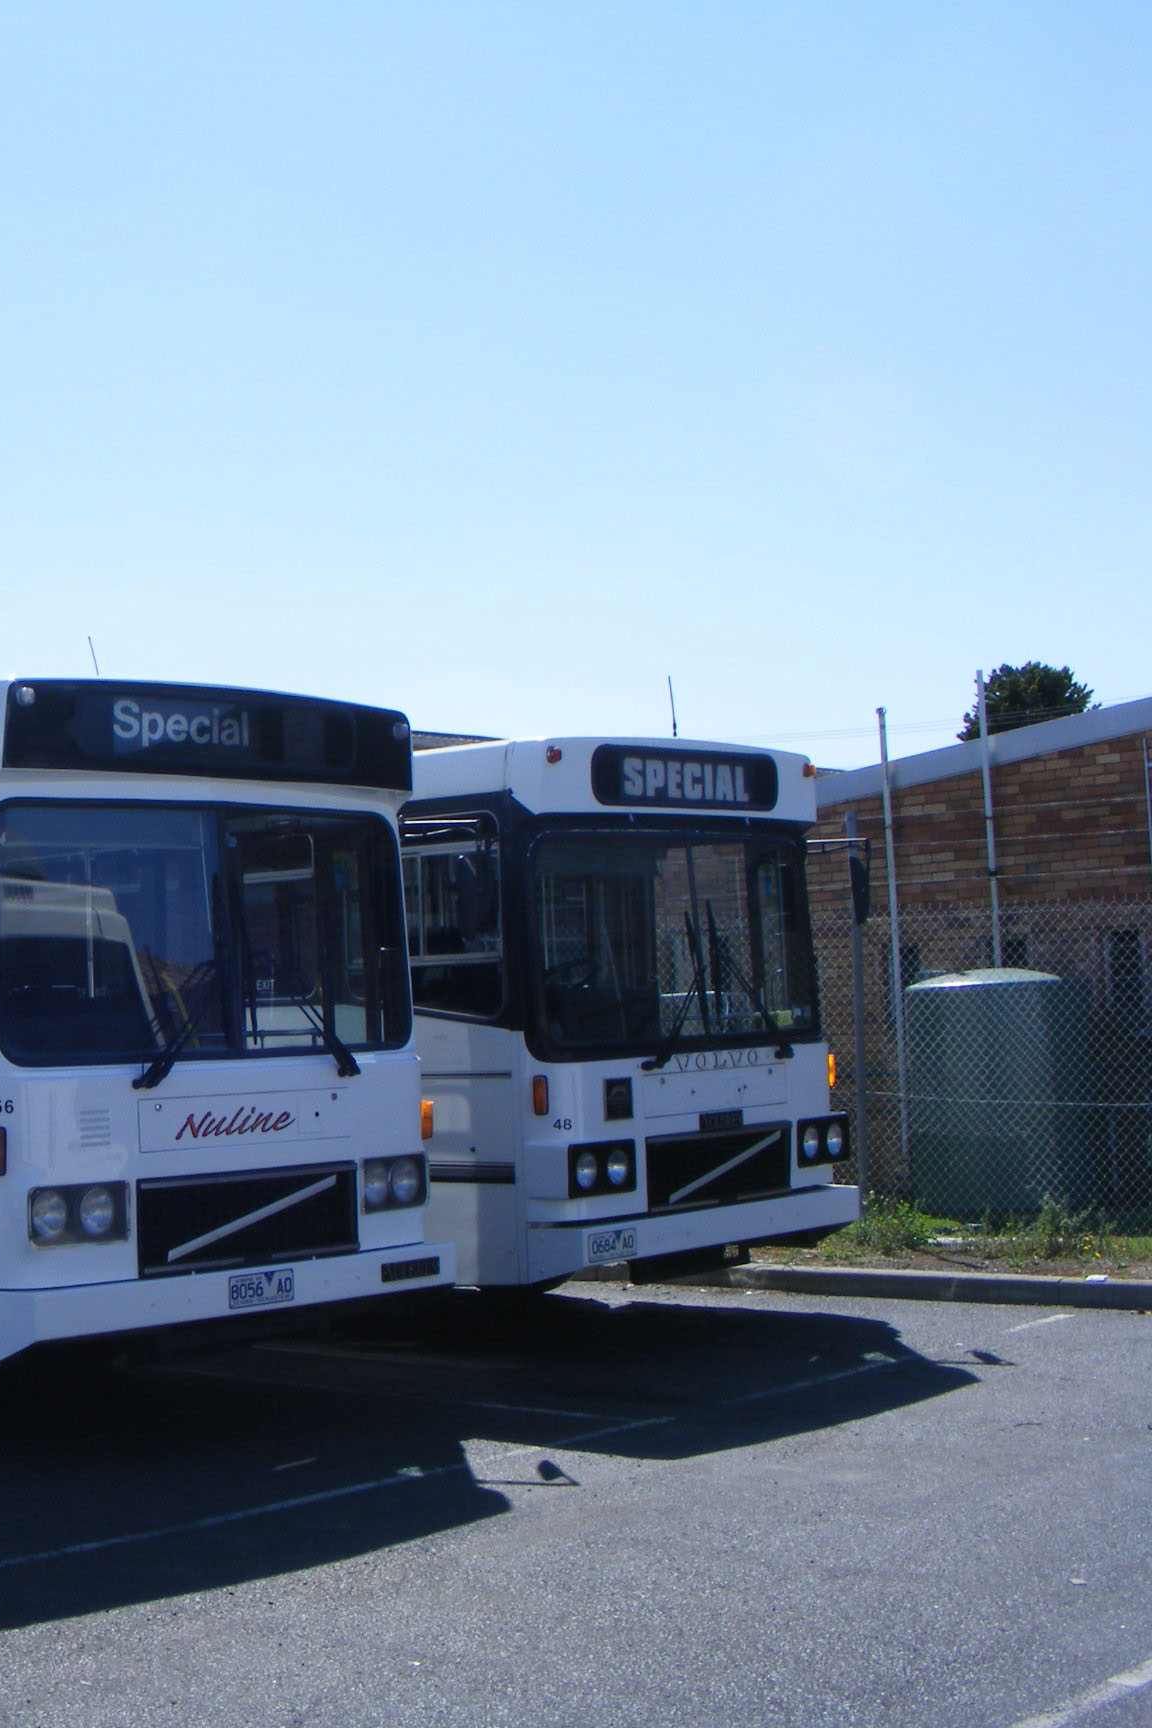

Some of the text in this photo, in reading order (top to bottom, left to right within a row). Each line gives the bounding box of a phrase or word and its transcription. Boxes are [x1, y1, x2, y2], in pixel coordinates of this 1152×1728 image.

[113, 699, 249, 747] Special
[622, 757, 750, 802] SPECIAL
[674, 1049, 758, 1072] VOLVO
[175, 1105, 296, 1141] Nuline
[553, 1119, 572, 1130] 48
[231, 1280, 264, 1300] 8056
